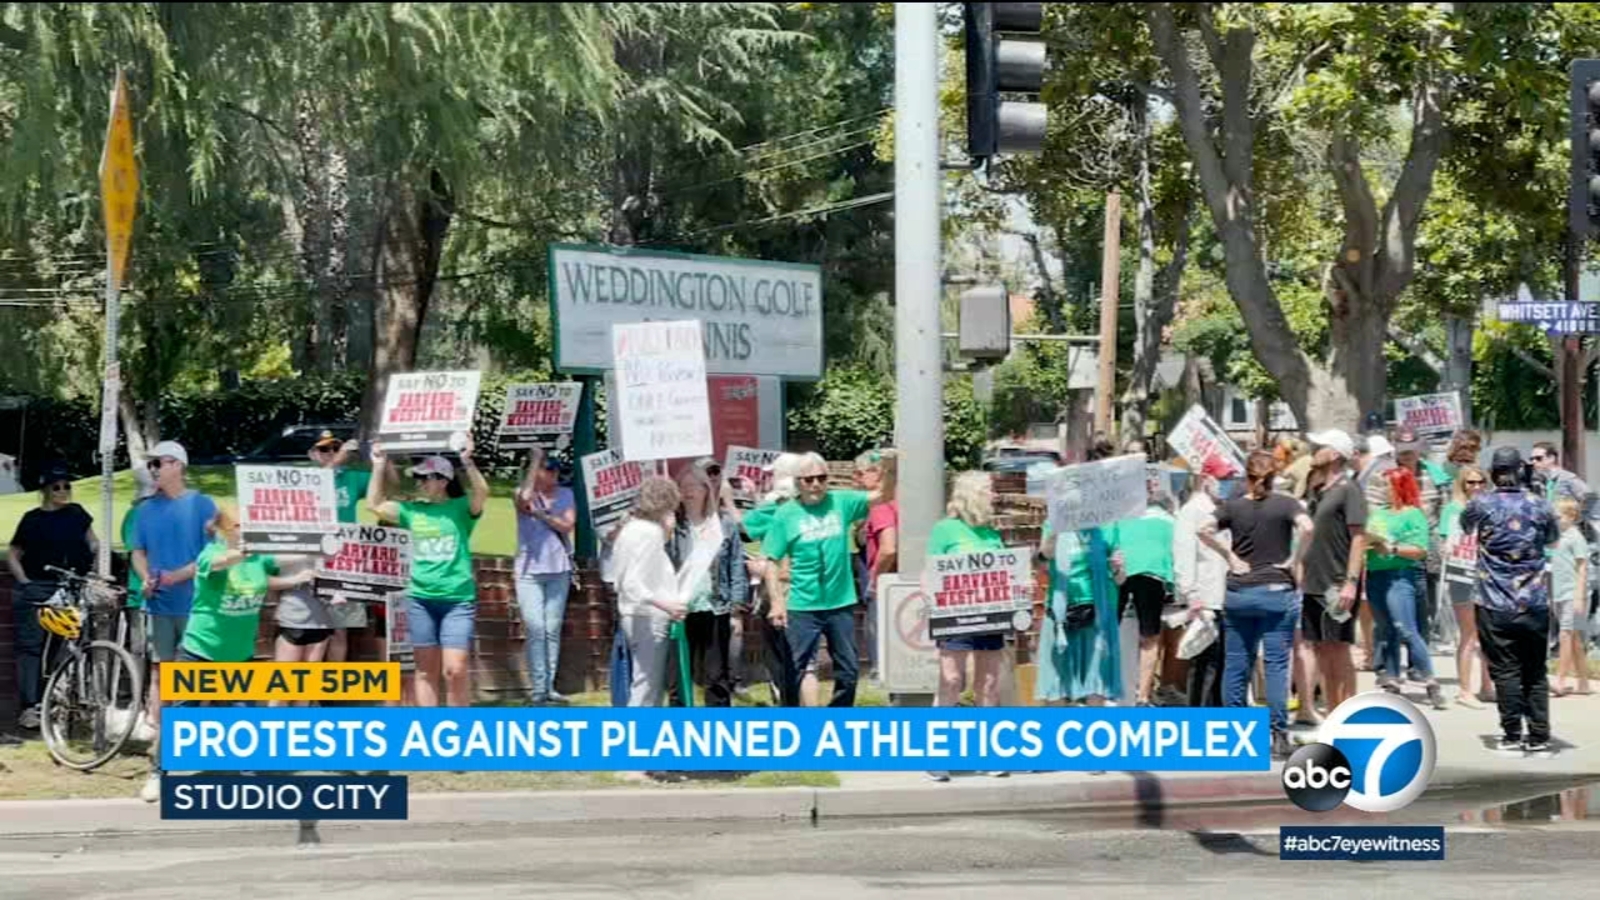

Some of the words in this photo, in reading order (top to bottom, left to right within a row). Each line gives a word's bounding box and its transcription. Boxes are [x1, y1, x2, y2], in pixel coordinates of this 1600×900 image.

[564, 262, 747, 315] WEDDINGTON
[754, 279, 814, 317] GOLF
[1499, 303, 1567, 320] WHITSETT
[1571, 302, 1597, 319] AVE
[424, 373, 448, 388] NO
[536, 384, 557, 398] NO
[735, 451, 760, 463] SAY
[247, 471, 274, 485] SAY
[276, 469, 302, 487] NO
[304, 473, 321, 486] TO
[253, 488, 321, 506] HARVARD-
[336, 527, 356, 539] AY
[359, 526, 387, 543] NO
[389, 532, 409, 545] TO
[343, 542, 407, 561] ARVARD-
[936, 558, 966, 572] SAY
[967, 552, 996, 570] NO
[998, 554, 1018, 567] TO
[942, 570, 1016, 591] HARVARD-
